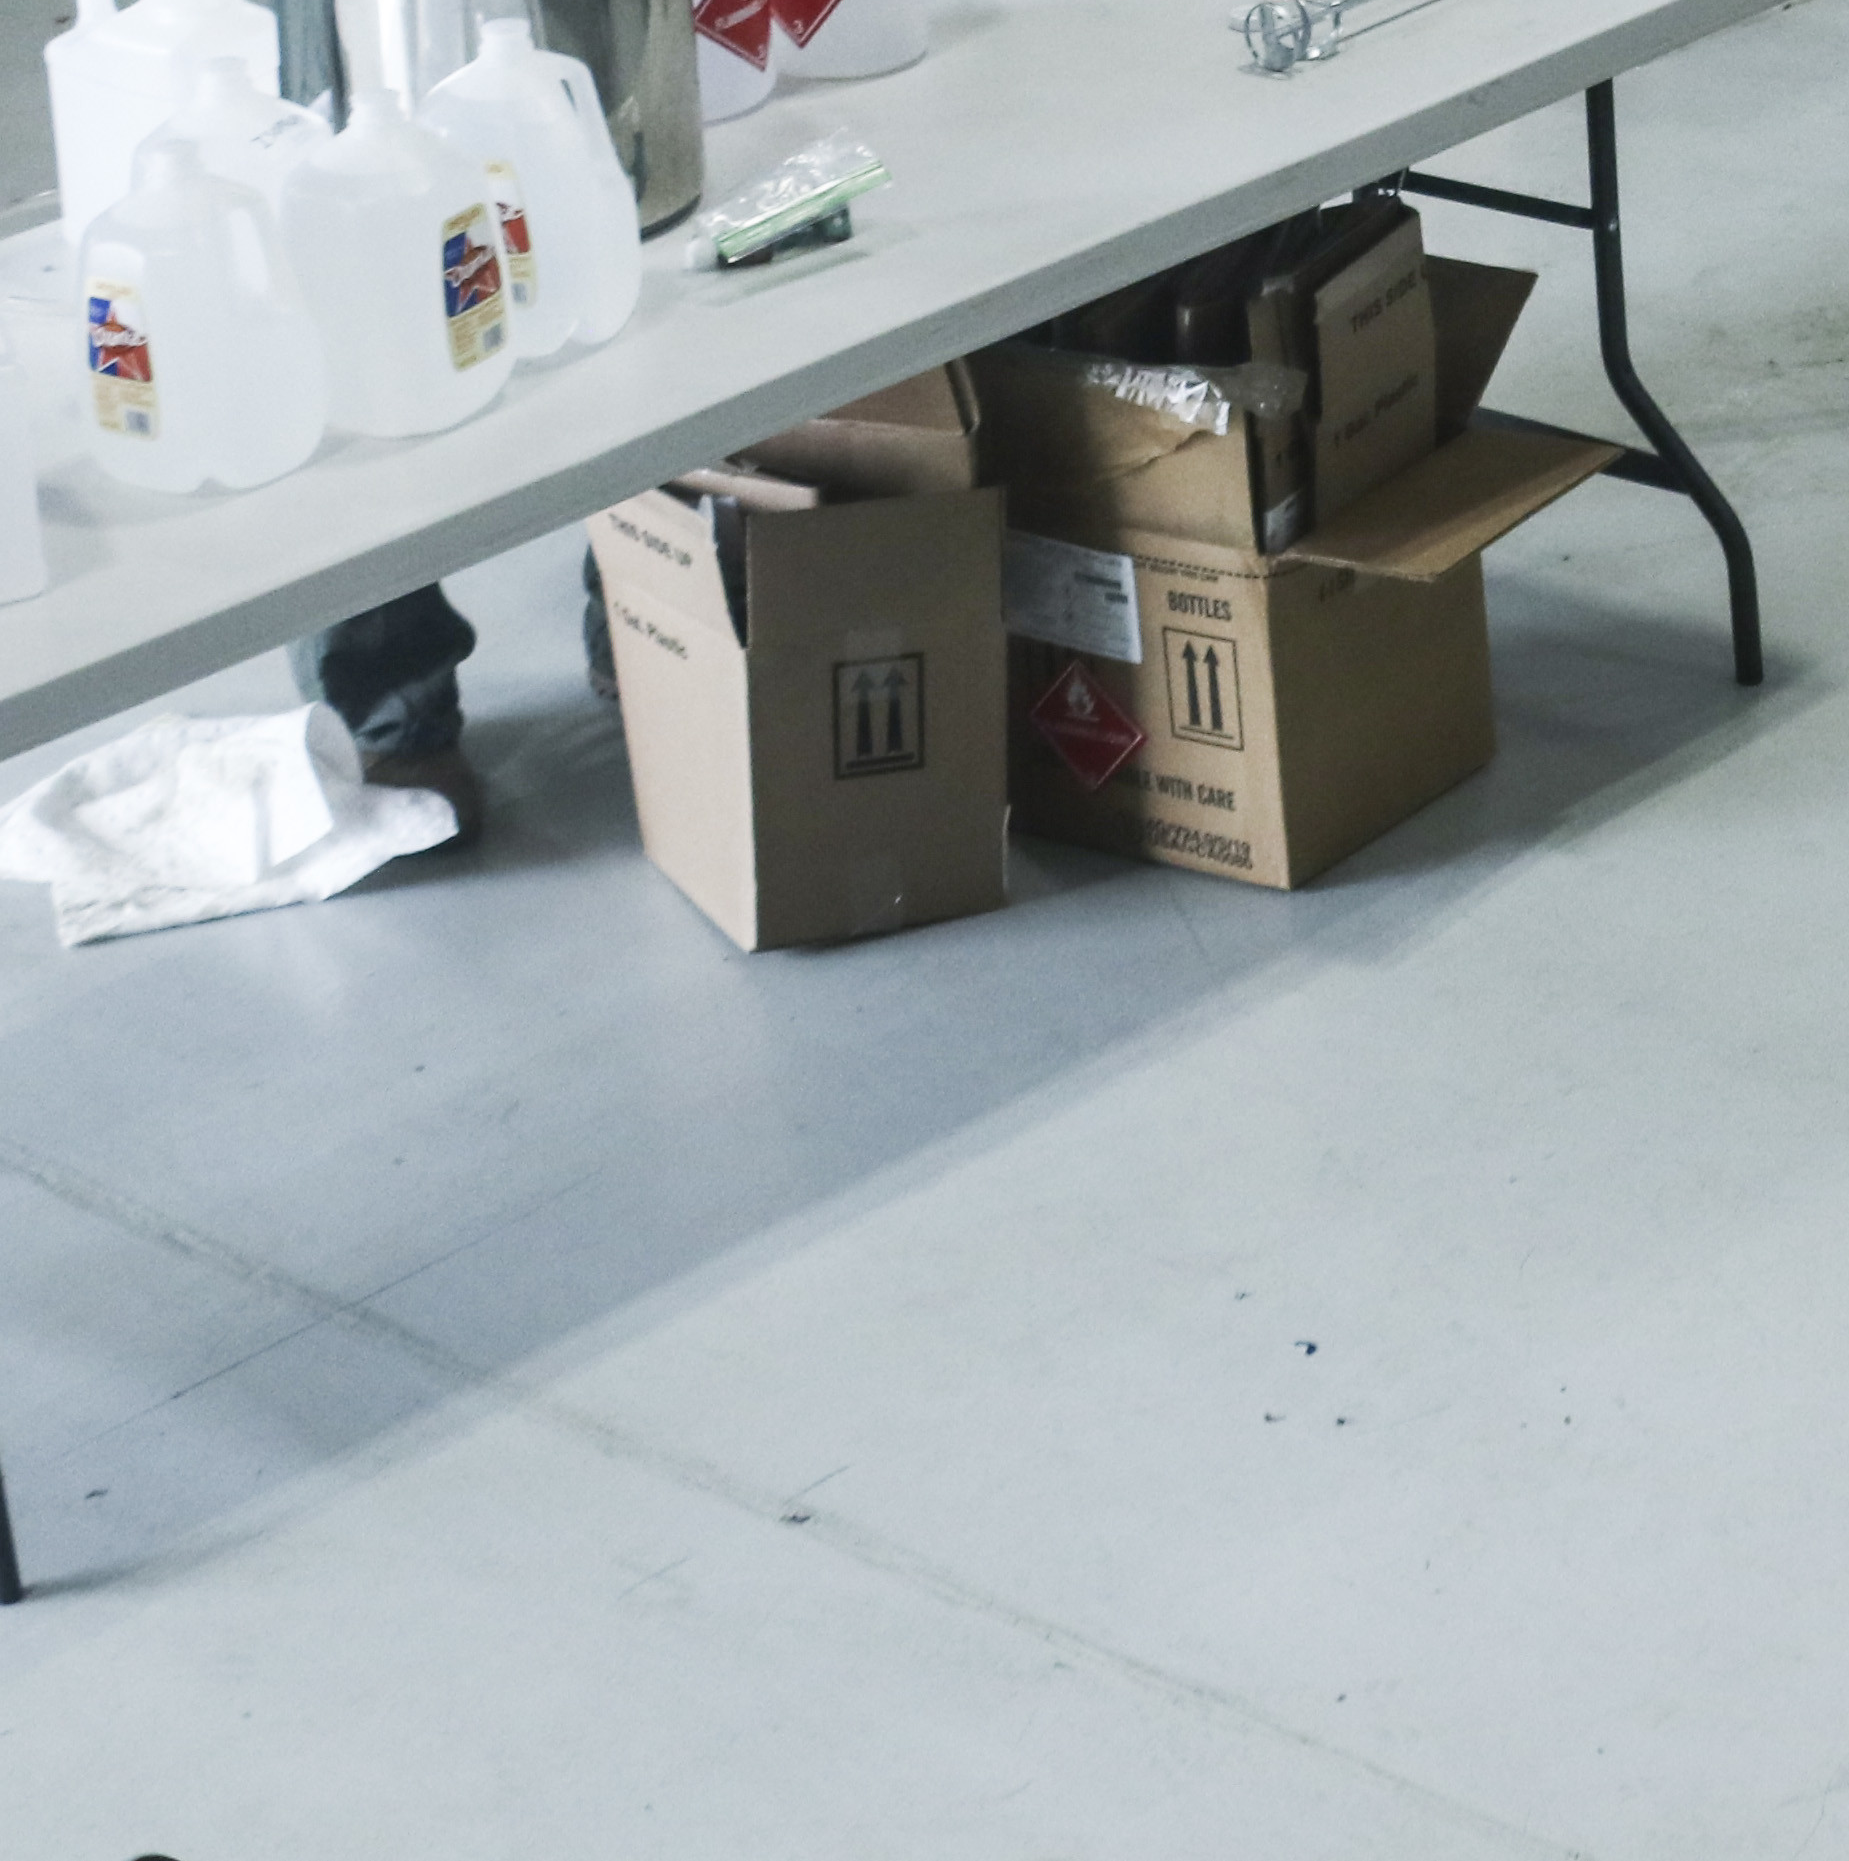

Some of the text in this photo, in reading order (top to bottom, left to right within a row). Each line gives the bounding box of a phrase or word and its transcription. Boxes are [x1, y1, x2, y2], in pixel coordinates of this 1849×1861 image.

[1352, 270, 1418, 333] THIS SIDE
[608, 512, 693, 568] THIS SIDE UP
[1168, 590, 1232, 621] BOTTLES
[1156, 774, 1193, 802] WITH
[1198, 783, 1236, 812] CARE
